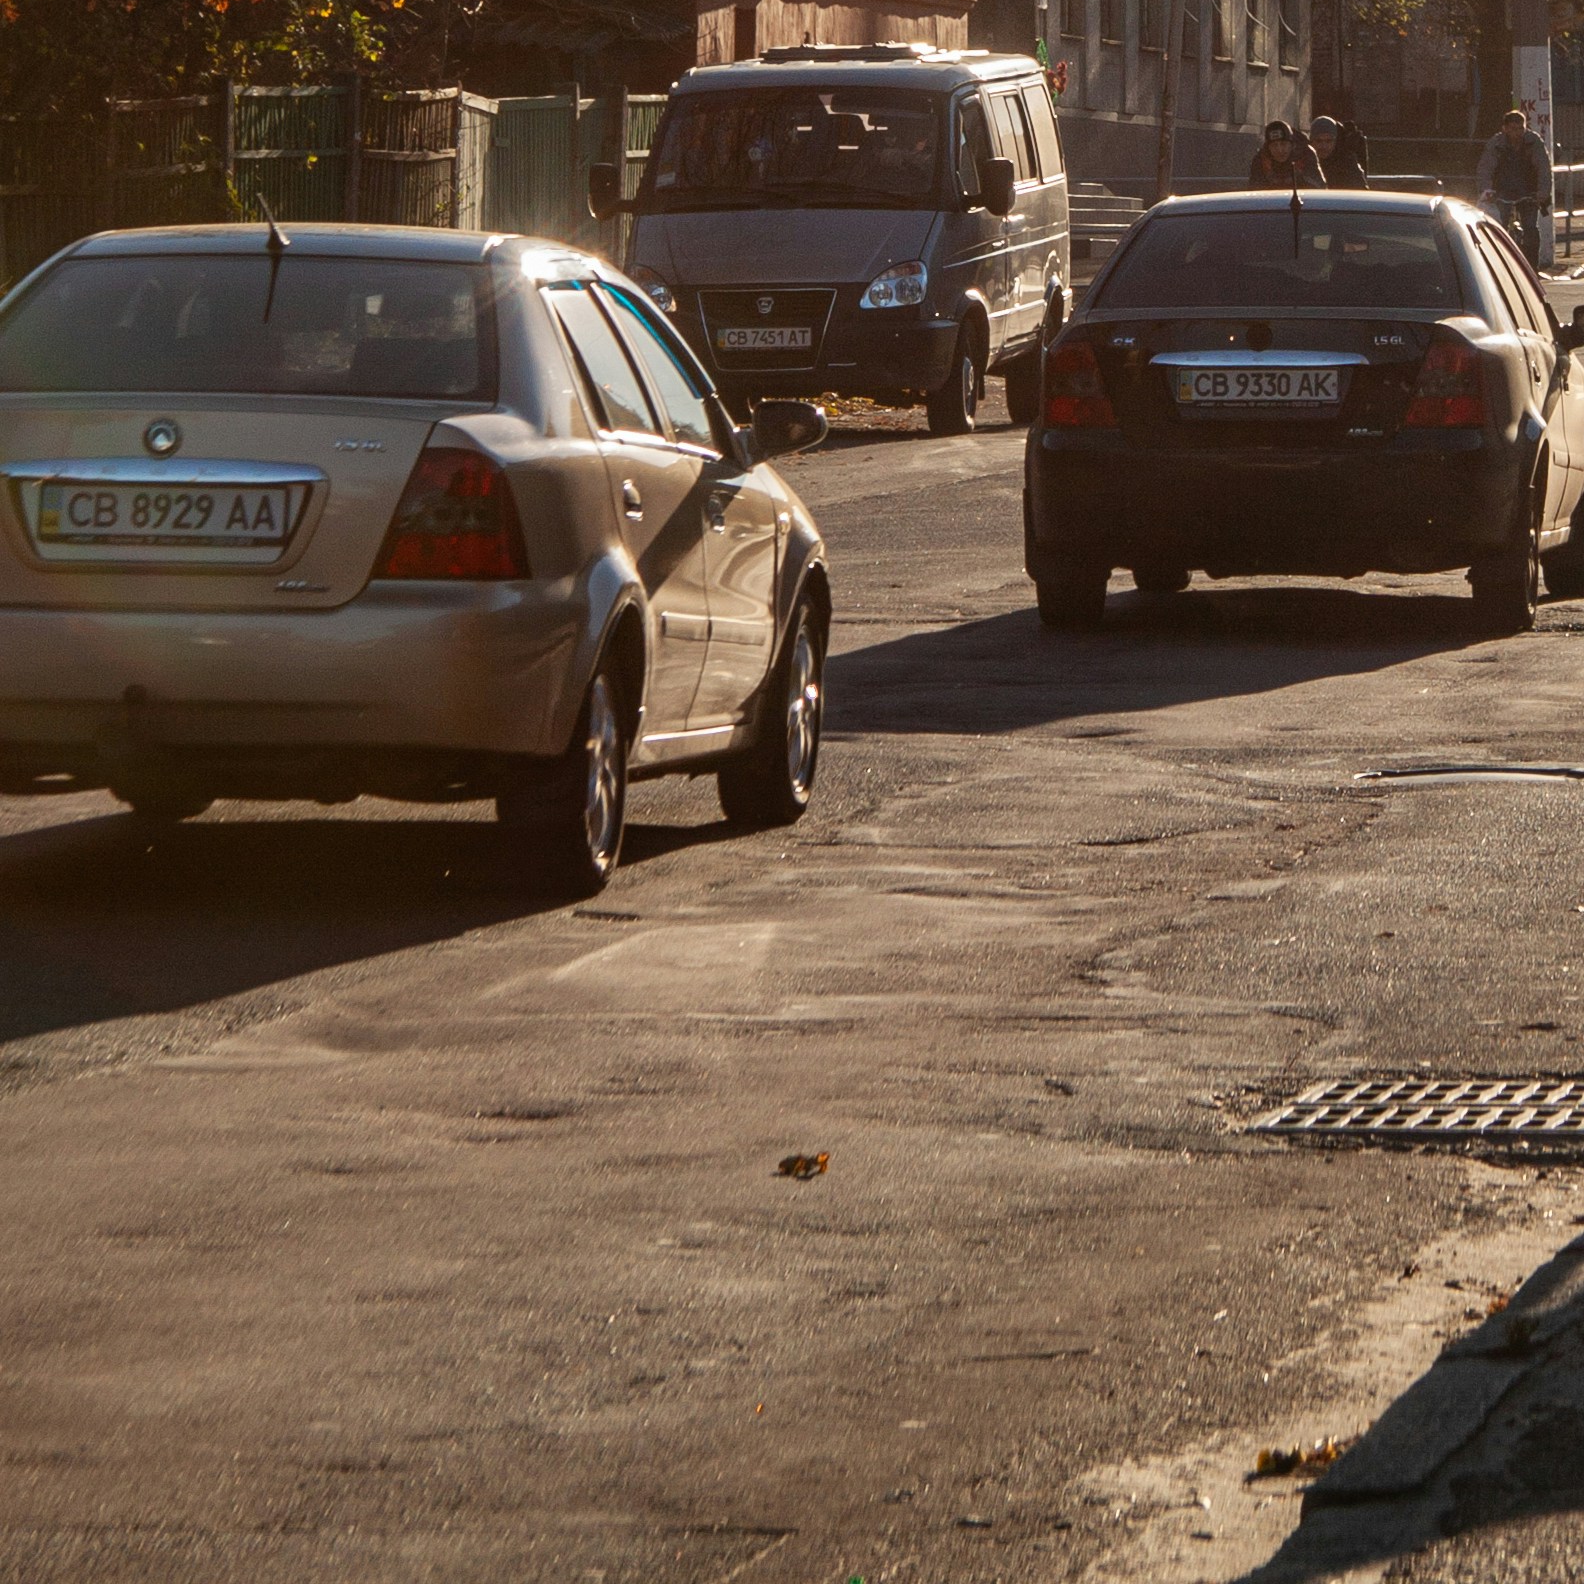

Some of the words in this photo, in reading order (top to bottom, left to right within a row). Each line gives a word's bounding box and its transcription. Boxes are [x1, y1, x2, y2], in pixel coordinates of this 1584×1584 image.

[726, 331, 748, 346] CB
[751, 330, 785, 346] 7451
[787, 329, 809, 346] AT
[1194, 372, 1230, 398] CB
[1235, 372, 1291, 398] 9330
[1297, 372, 1331, 397] AK
[67, 491, 119, 529] CB
[130, 493, 214, 530] 8929
[225, 494, 276, 531] AA
